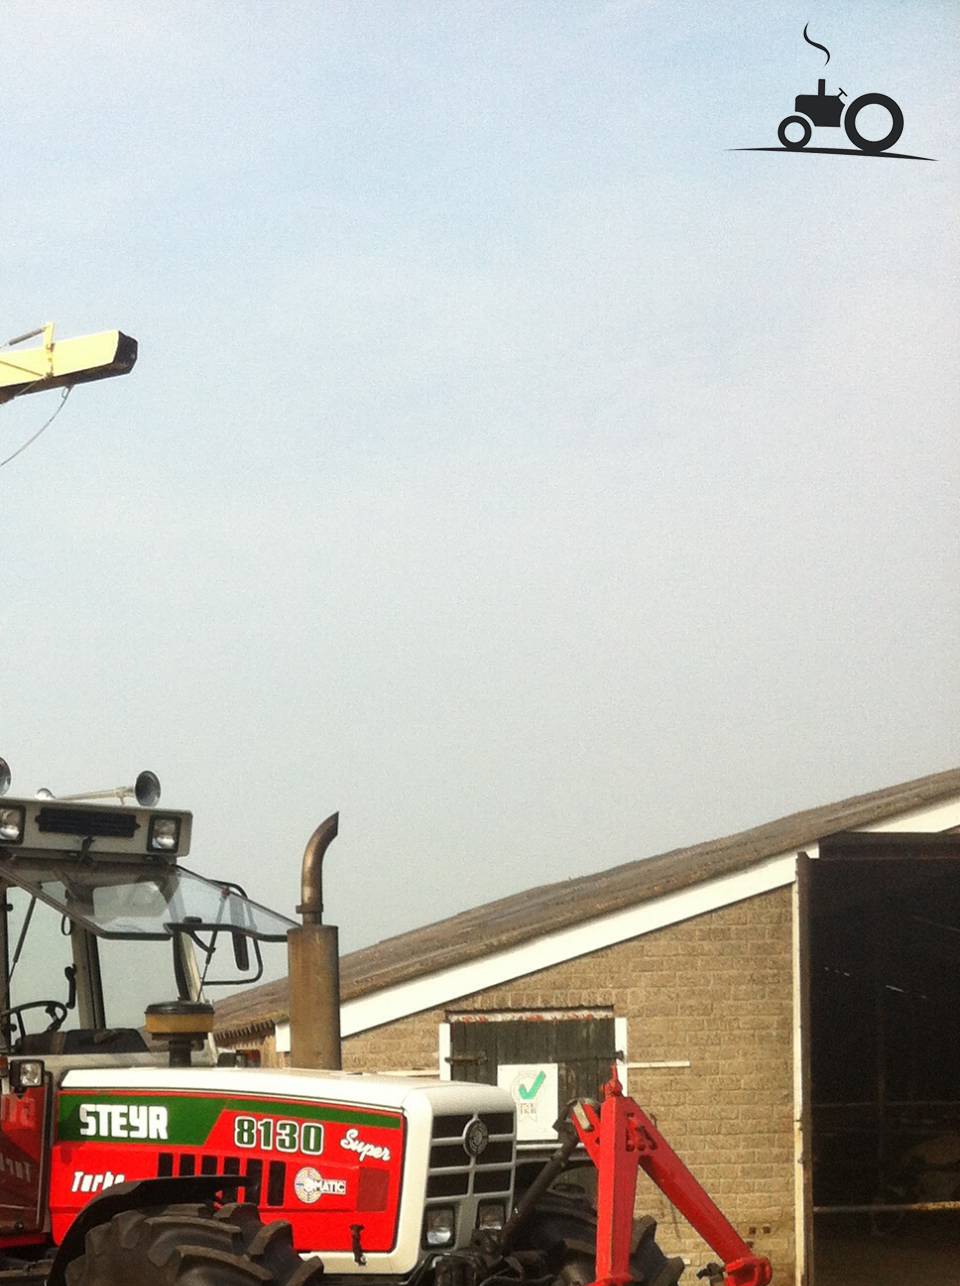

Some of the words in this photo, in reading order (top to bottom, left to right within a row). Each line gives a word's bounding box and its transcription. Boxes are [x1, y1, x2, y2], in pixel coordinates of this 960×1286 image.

[79, 1103, 168, 1140] STEYR
[234, 1115, 324, 1155] 8130
[340, 1128, 391, 1161] Super
